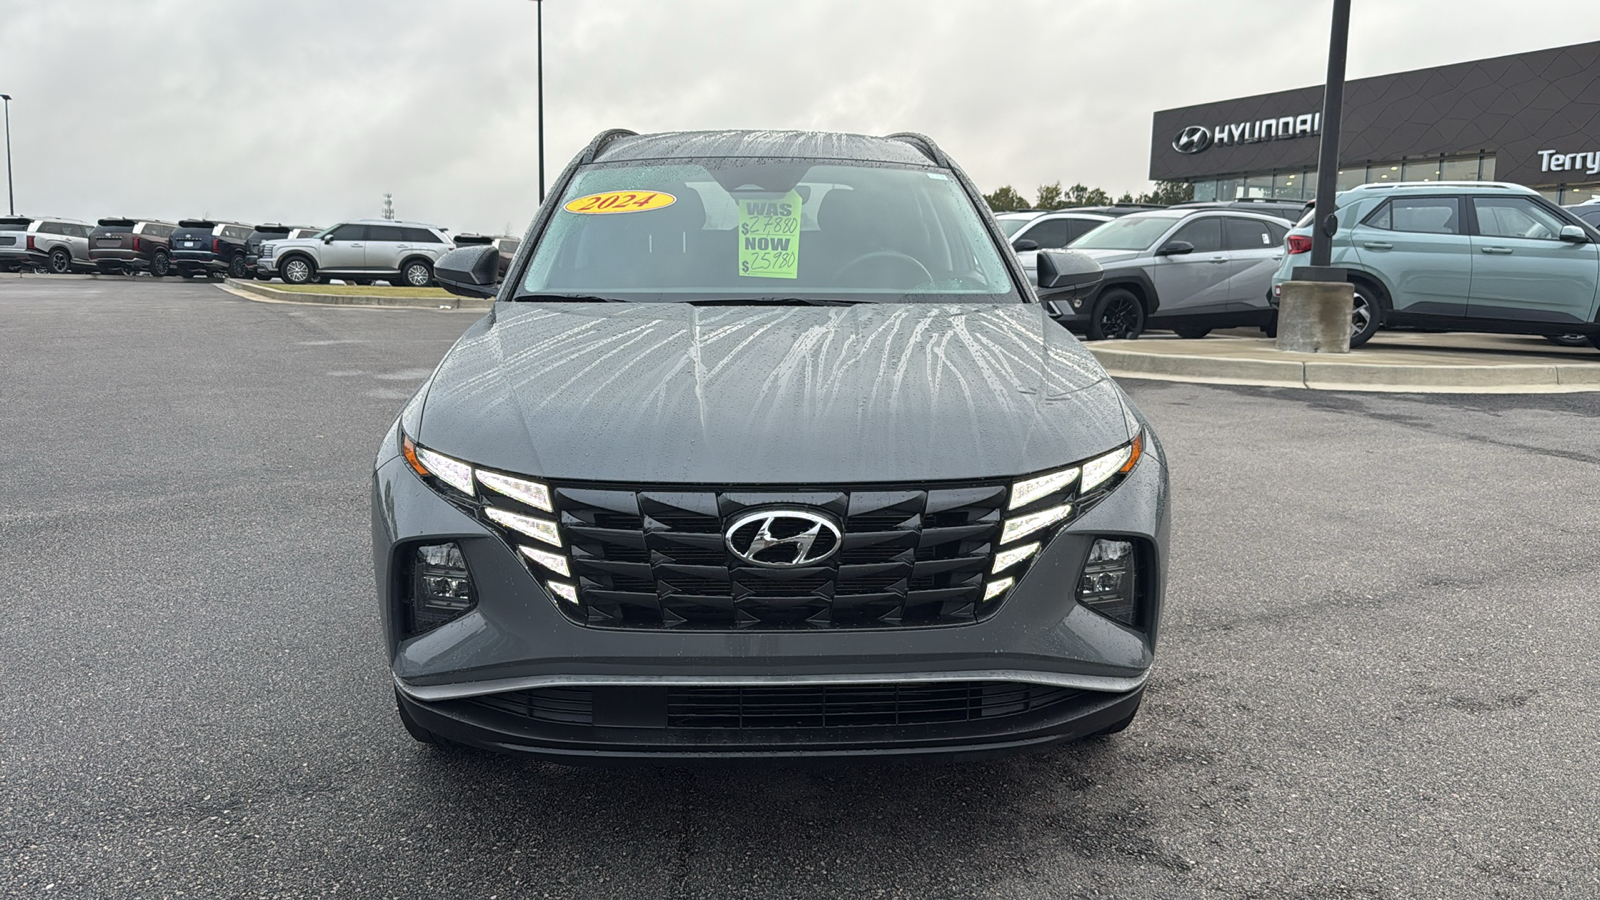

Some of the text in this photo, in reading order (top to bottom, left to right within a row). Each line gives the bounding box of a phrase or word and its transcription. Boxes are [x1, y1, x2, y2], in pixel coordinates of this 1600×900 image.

[1214, 112, 1320, 144] HYUNDAI
[1537, 149, 1600, 174] Terry
[577, 193, 657, 211] 2024
[746, 202, 792, 217] WAS
[745, 237, 791, 251] NOW
